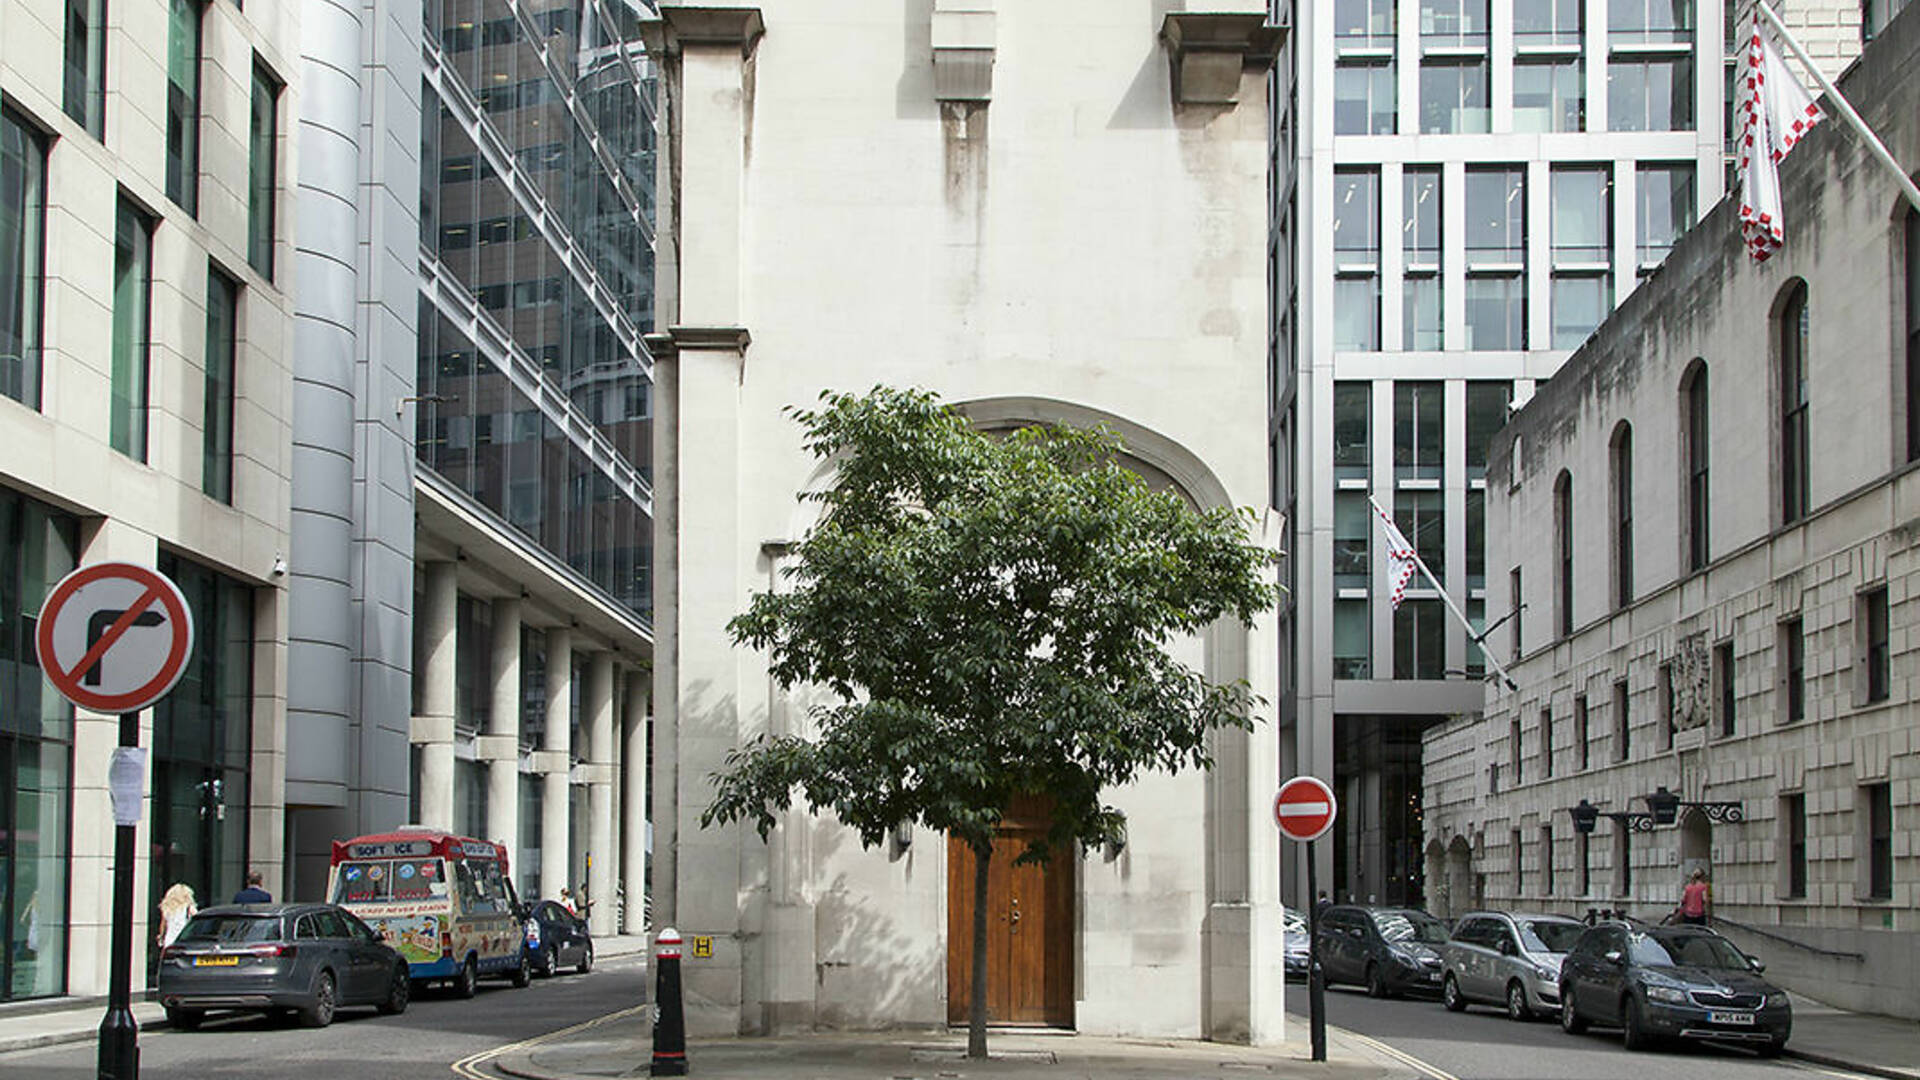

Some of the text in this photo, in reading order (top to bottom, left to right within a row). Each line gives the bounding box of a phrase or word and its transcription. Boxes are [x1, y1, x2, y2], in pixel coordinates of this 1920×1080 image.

[358, 843, 413, 857] SOFT ICE
[387, 906, 415, 914] NEVER
[696, 938, 710, 954] H
